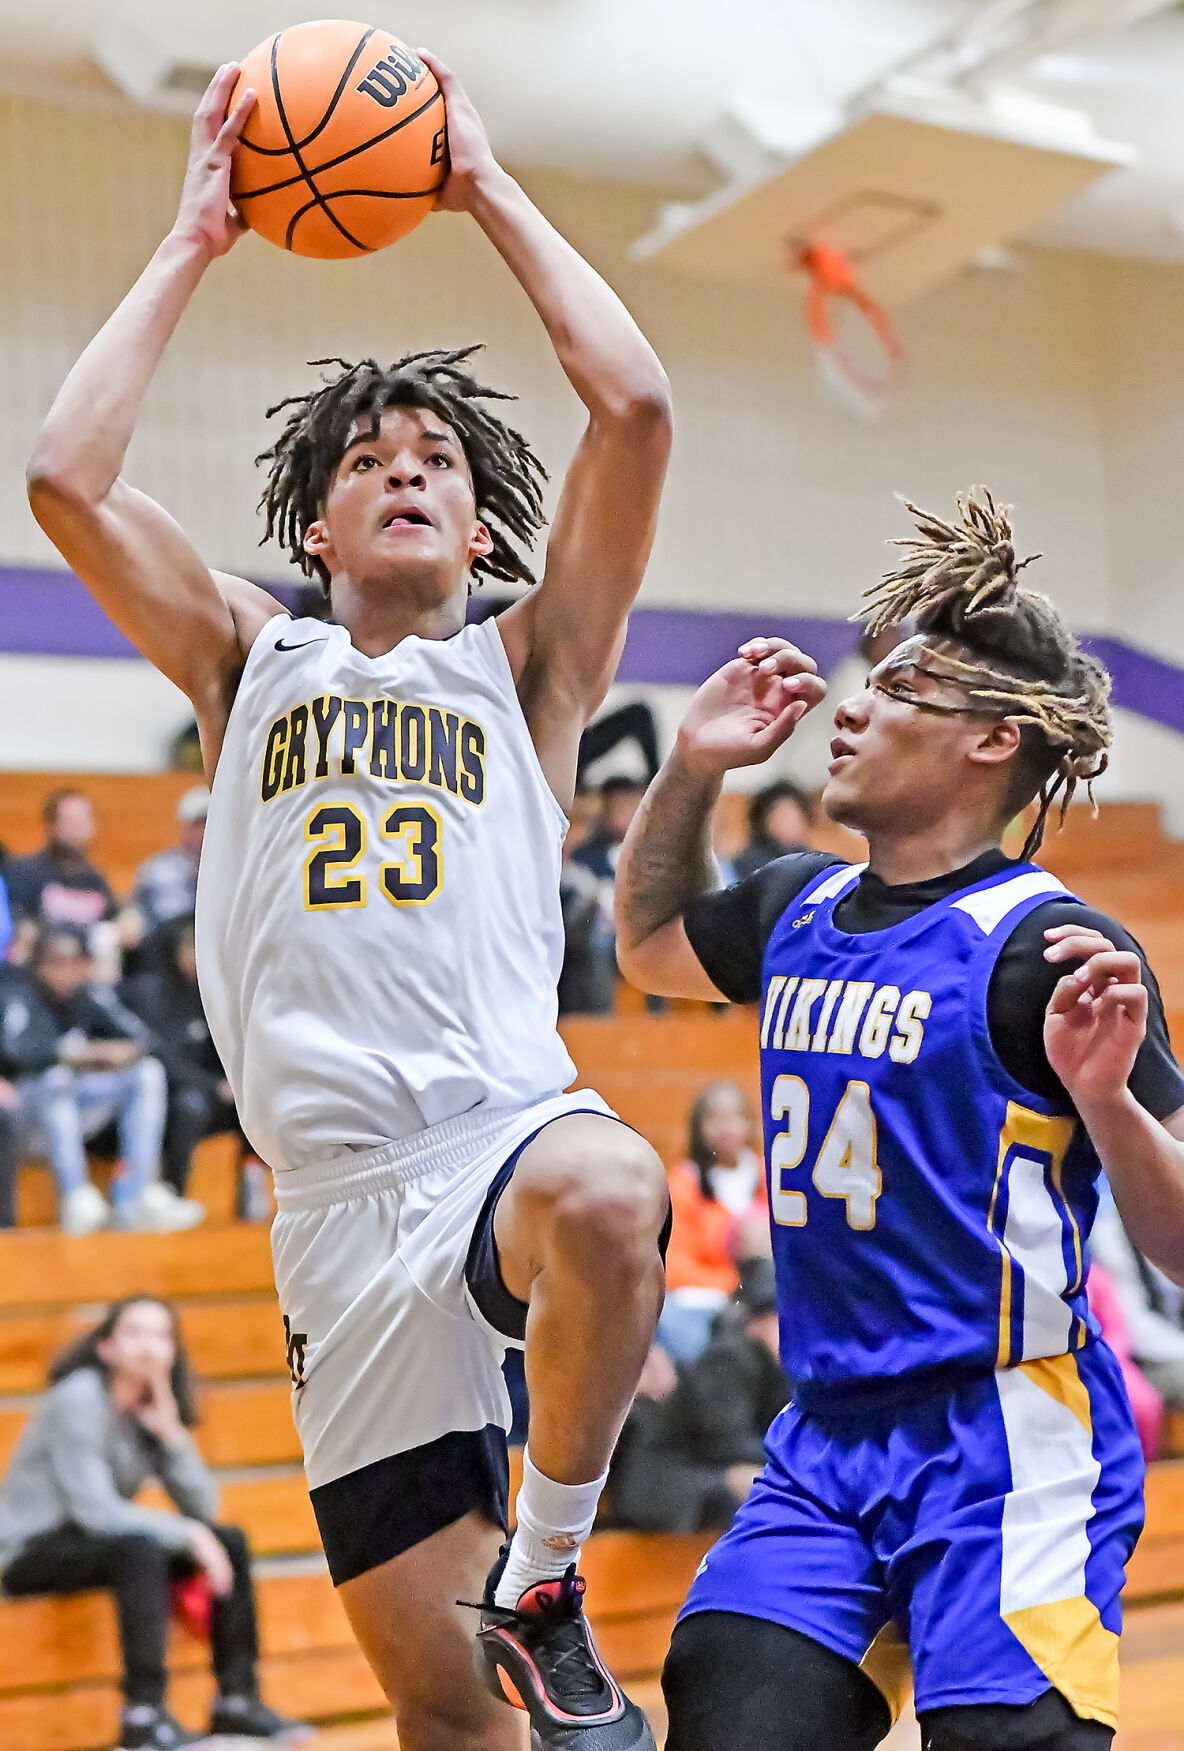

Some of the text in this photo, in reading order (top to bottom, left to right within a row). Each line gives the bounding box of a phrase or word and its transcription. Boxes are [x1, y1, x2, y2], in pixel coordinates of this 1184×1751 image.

[355, 44, 424, 108] Wil
[260, 694, 487, 806] GRYPHONS
[303, 801, 443, 911] 23
[760, 975, 932, 1064] VIKINGS
[770, 1074, 882, 1231] 24
